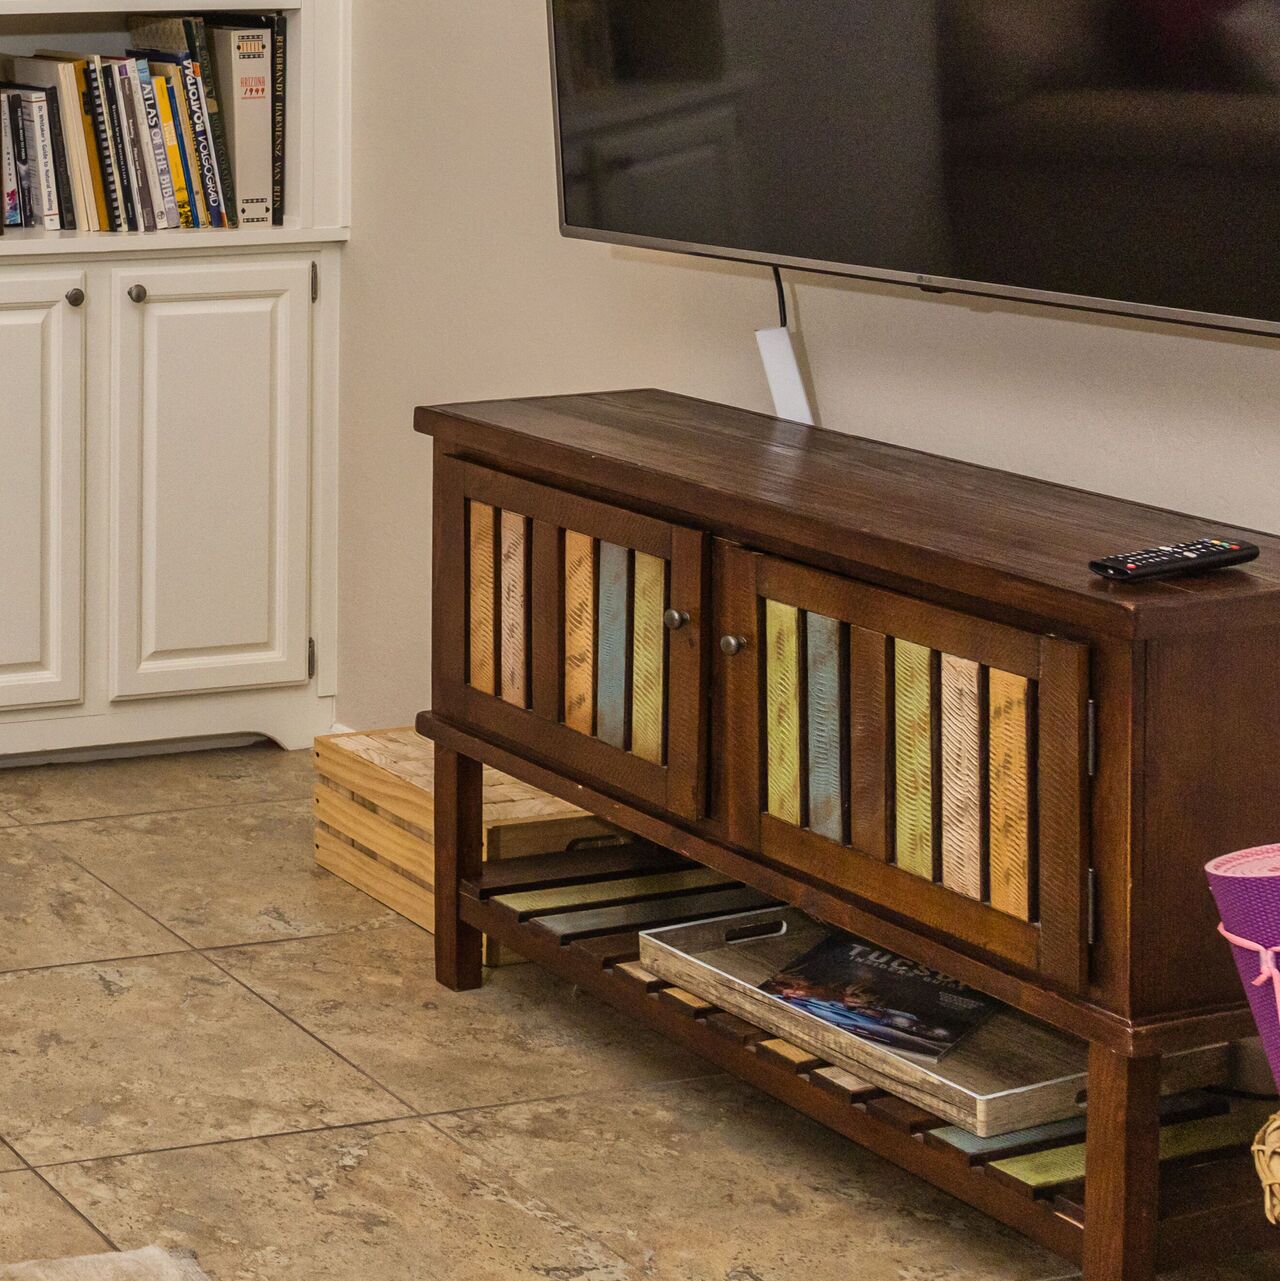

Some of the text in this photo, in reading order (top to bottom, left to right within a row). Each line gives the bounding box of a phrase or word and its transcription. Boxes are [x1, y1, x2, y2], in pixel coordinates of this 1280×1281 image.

[240, 76, 266, 88] ARIZONA
[244, 87, 265, 95] 1999
[38, 114, 46, 143] Whitaker's
[273, 35, 284, 208] REMBRANDT HARMENSZ VAN RIJN
[41, 144, 49, 160] Guide
[142, 83, 176, 211] ATLAS OF THE BIBLE
[197, 135, 219, 206] VOLGOGRAD
[46, 190, 54, 211] Healing
